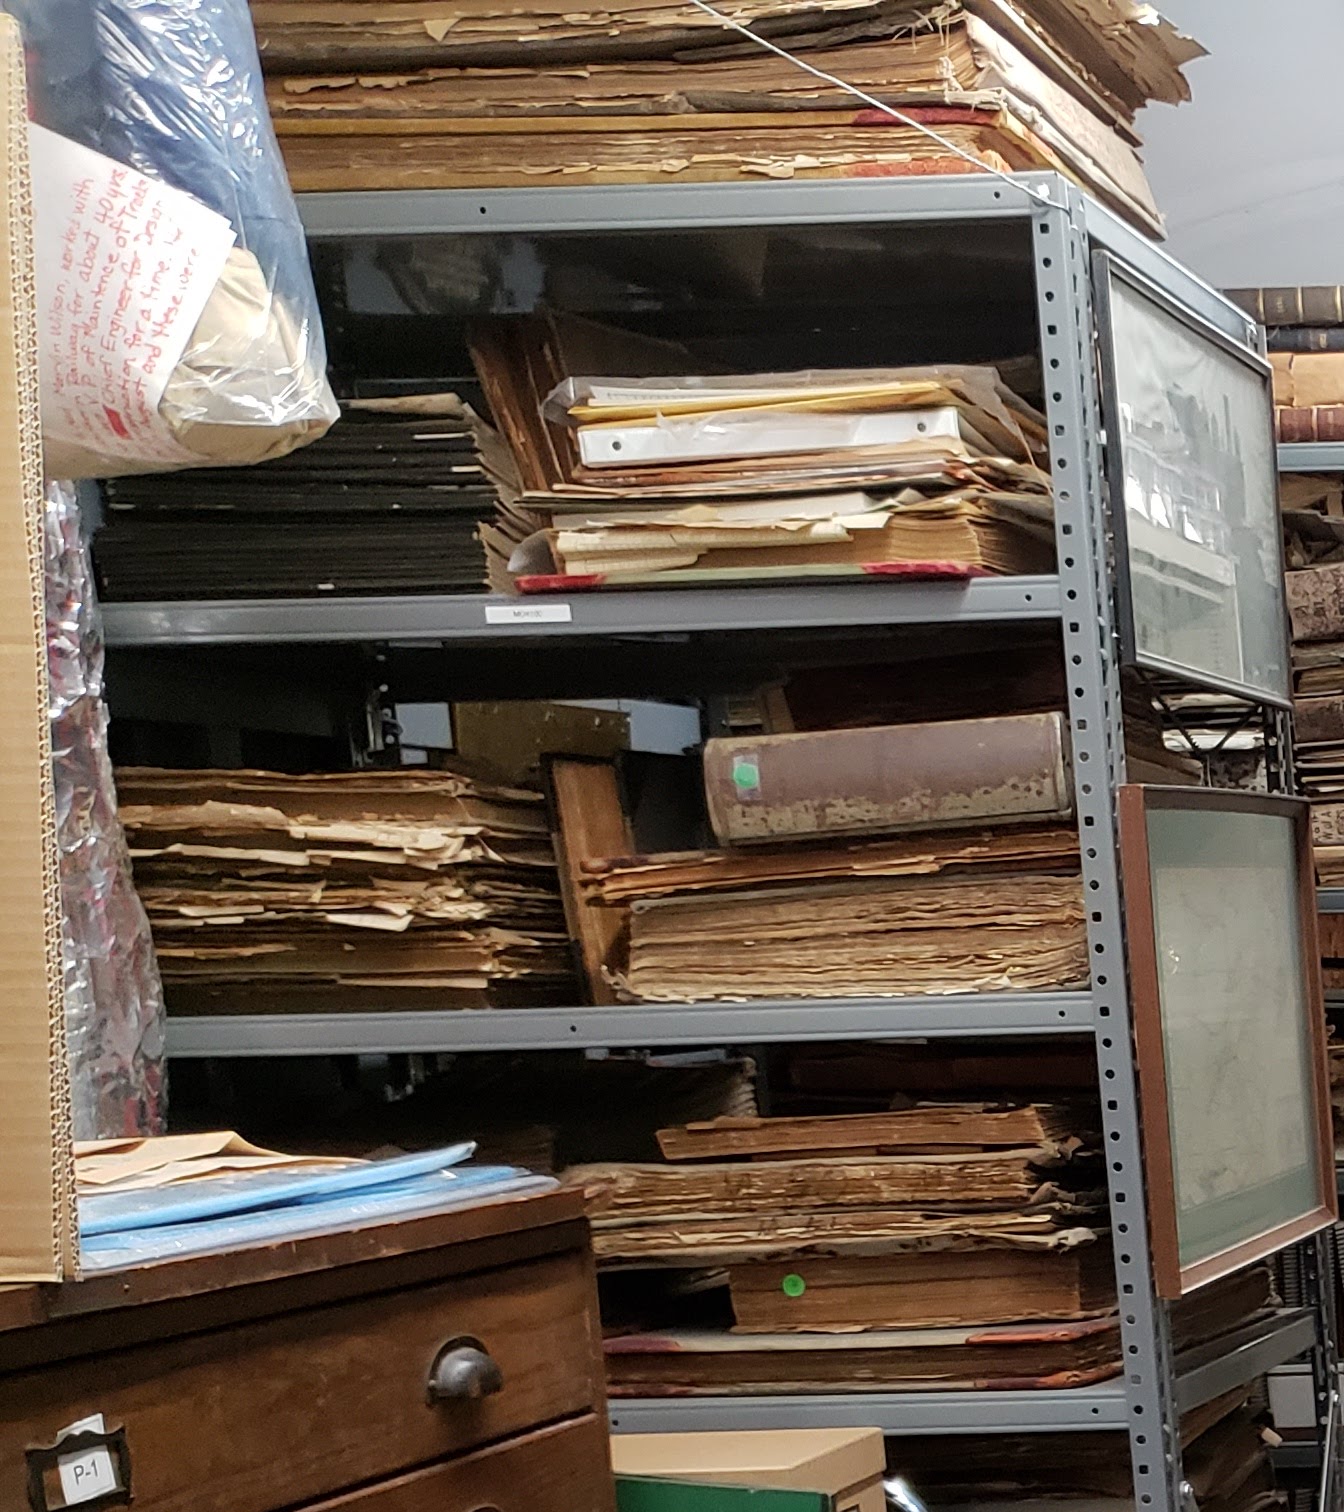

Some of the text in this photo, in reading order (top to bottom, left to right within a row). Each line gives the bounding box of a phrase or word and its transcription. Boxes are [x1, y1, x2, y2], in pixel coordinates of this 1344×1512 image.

[72, 178, 94, 215] with
[109, 219, 127, 249] of
[66, 289, 84, 318] for
[79, 229, 100, 284] about
[94, 197, 115, 225] 40
[100, 278, 134, 352] Engineer
[121, 249, 142, 278] for
[151, 293, 184, 338] these
[124, 319, 144, 350] for
[141, 342, 162, 376] and
[72, 1456, 100, 1486] P-1
